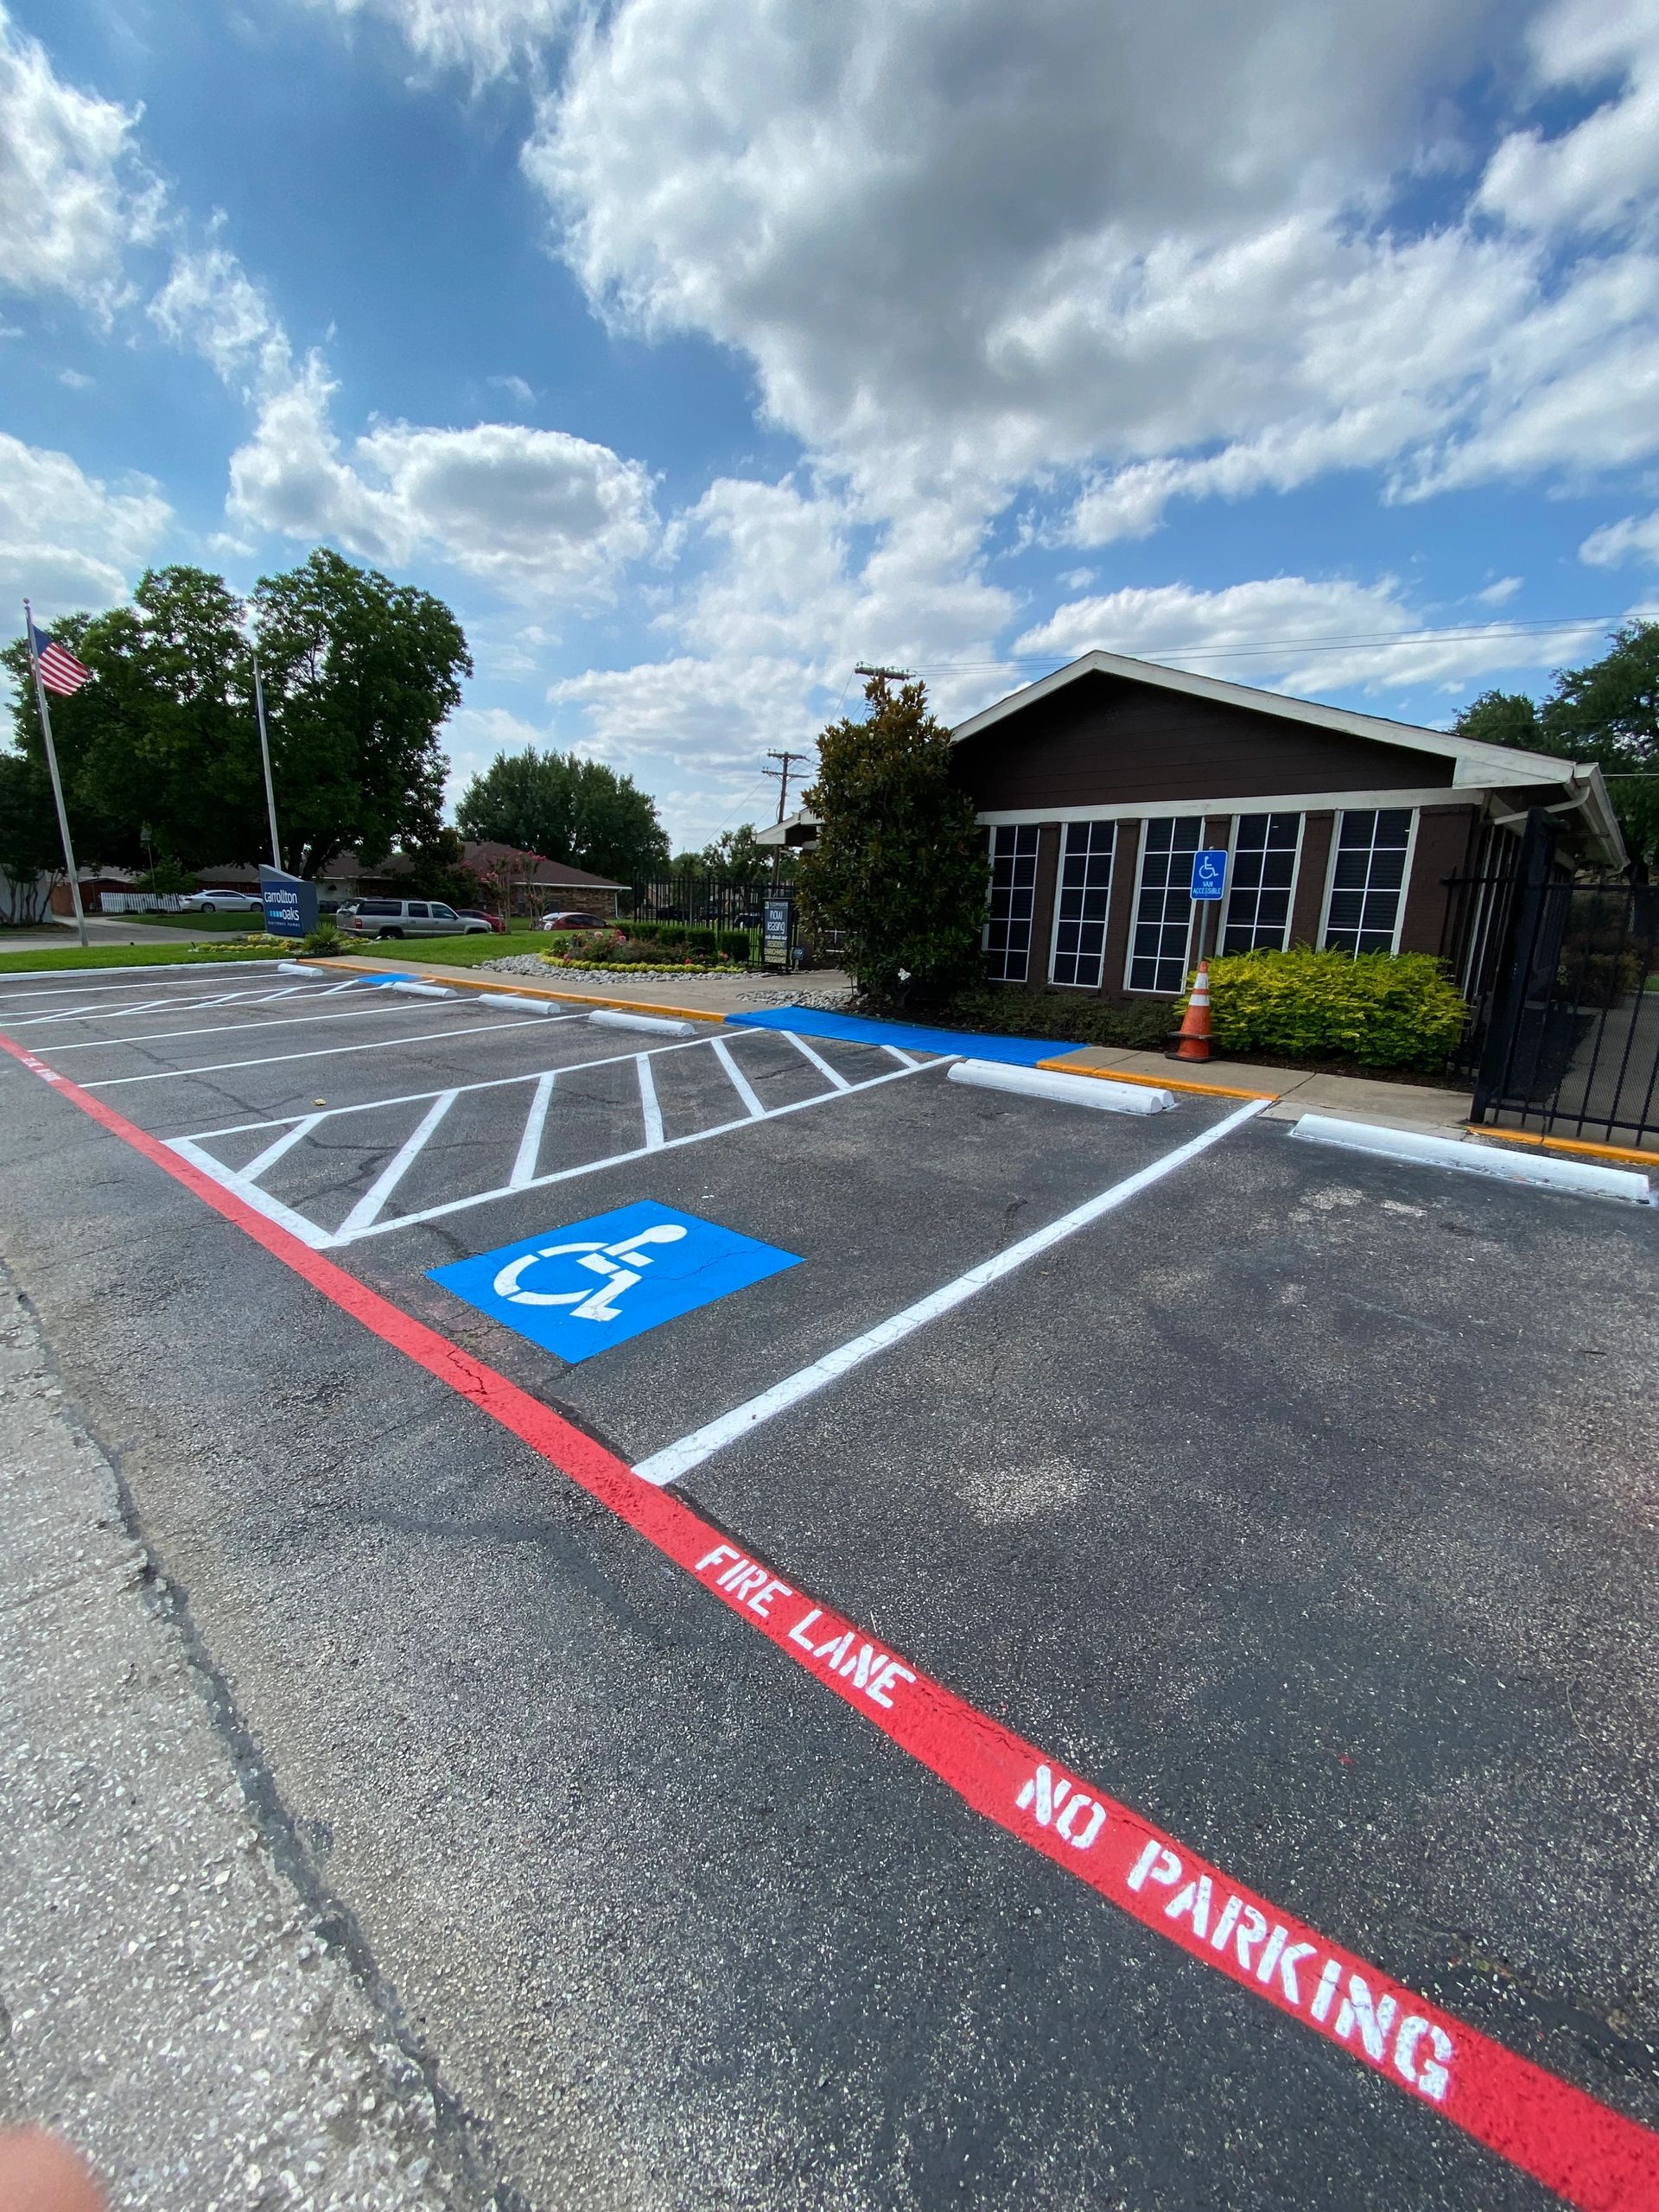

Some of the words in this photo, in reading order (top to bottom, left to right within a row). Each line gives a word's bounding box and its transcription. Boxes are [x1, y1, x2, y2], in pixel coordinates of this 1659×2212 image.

[264, 889, 297, 904] carrollton
[282, 906, 299, 920] oaks
[770, 910, 783, 920] now
[767, 921, 785, 934] leasing
[694, 1544, 793, 1618] FIRE
[788, 1609, 917, 1708] LANE
[1015, 1764, 1106, 1849] NO
[1127, 1840, 1453, 2101] PARKING
